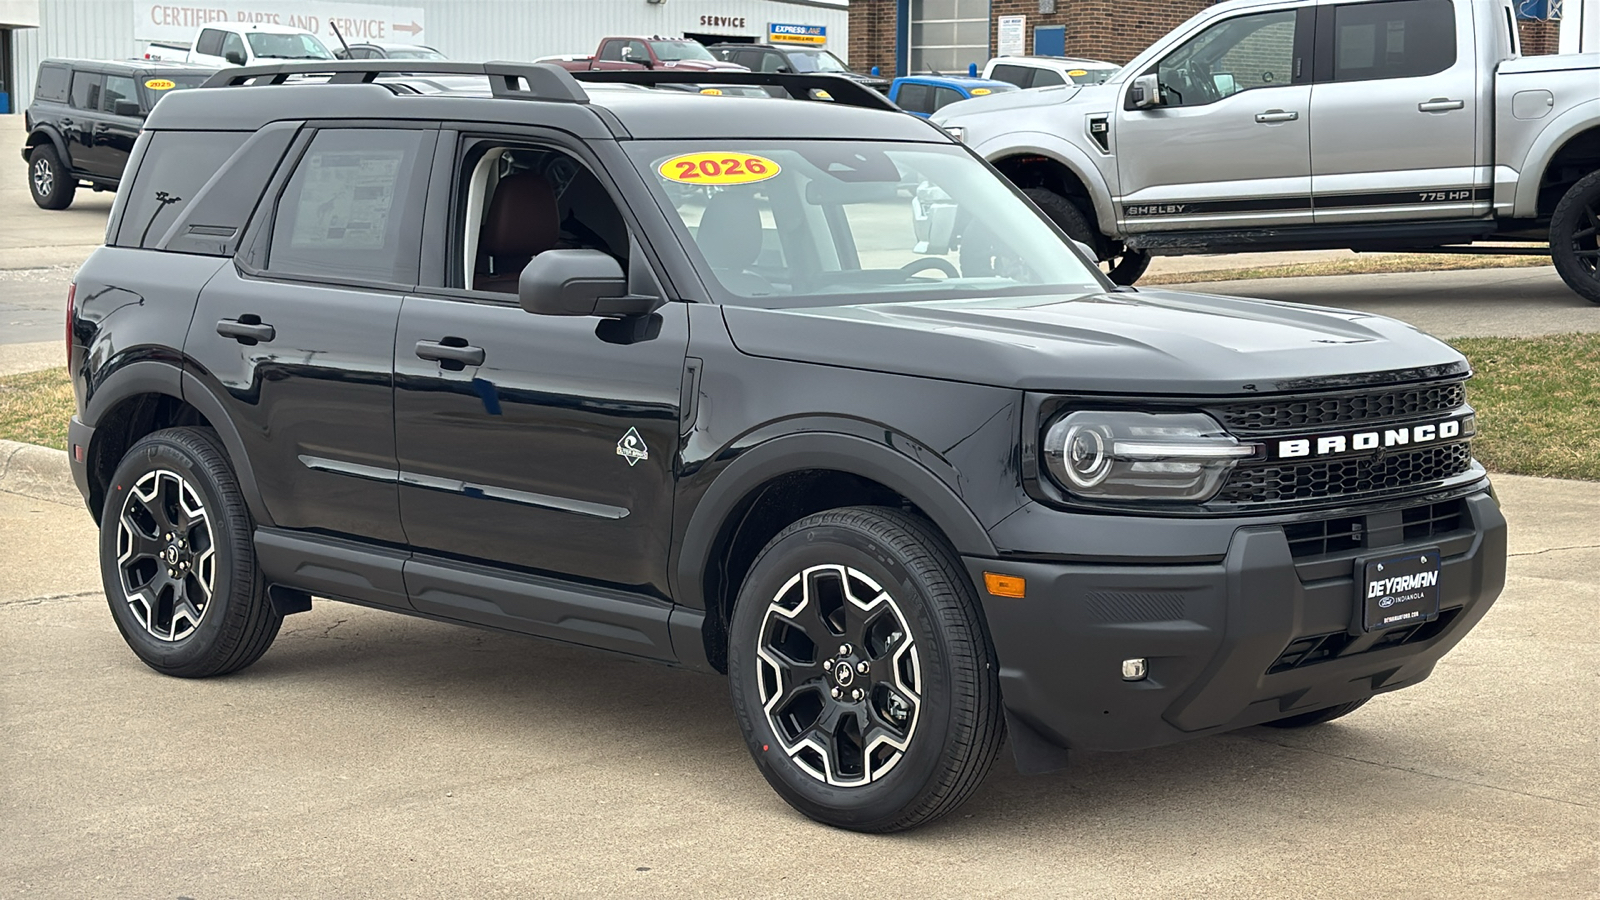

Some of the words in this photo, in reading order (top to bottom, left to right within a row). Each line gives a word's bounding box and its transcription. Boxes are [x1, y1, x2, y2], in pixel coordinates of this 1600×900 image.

[151, 4, 227, 25] CERTIFIED
[289, 15, 319, 35] AND
[328, 17, 385, 39] SERVICE
[700, 15, 745, 28] SERVICE
[676, 158, 767, 179] 2026
[1419, 192, 1446, 202] 775
[1449, 191, 1470, 200] HP
[1128, 204, 1186, 215] SHELBY
[1278, 421, 1459, 458] BRONCO
[1367, 570, 1439, 599] DEYARMAN
[1395, 592, 1425, 603] INDIANOLA
